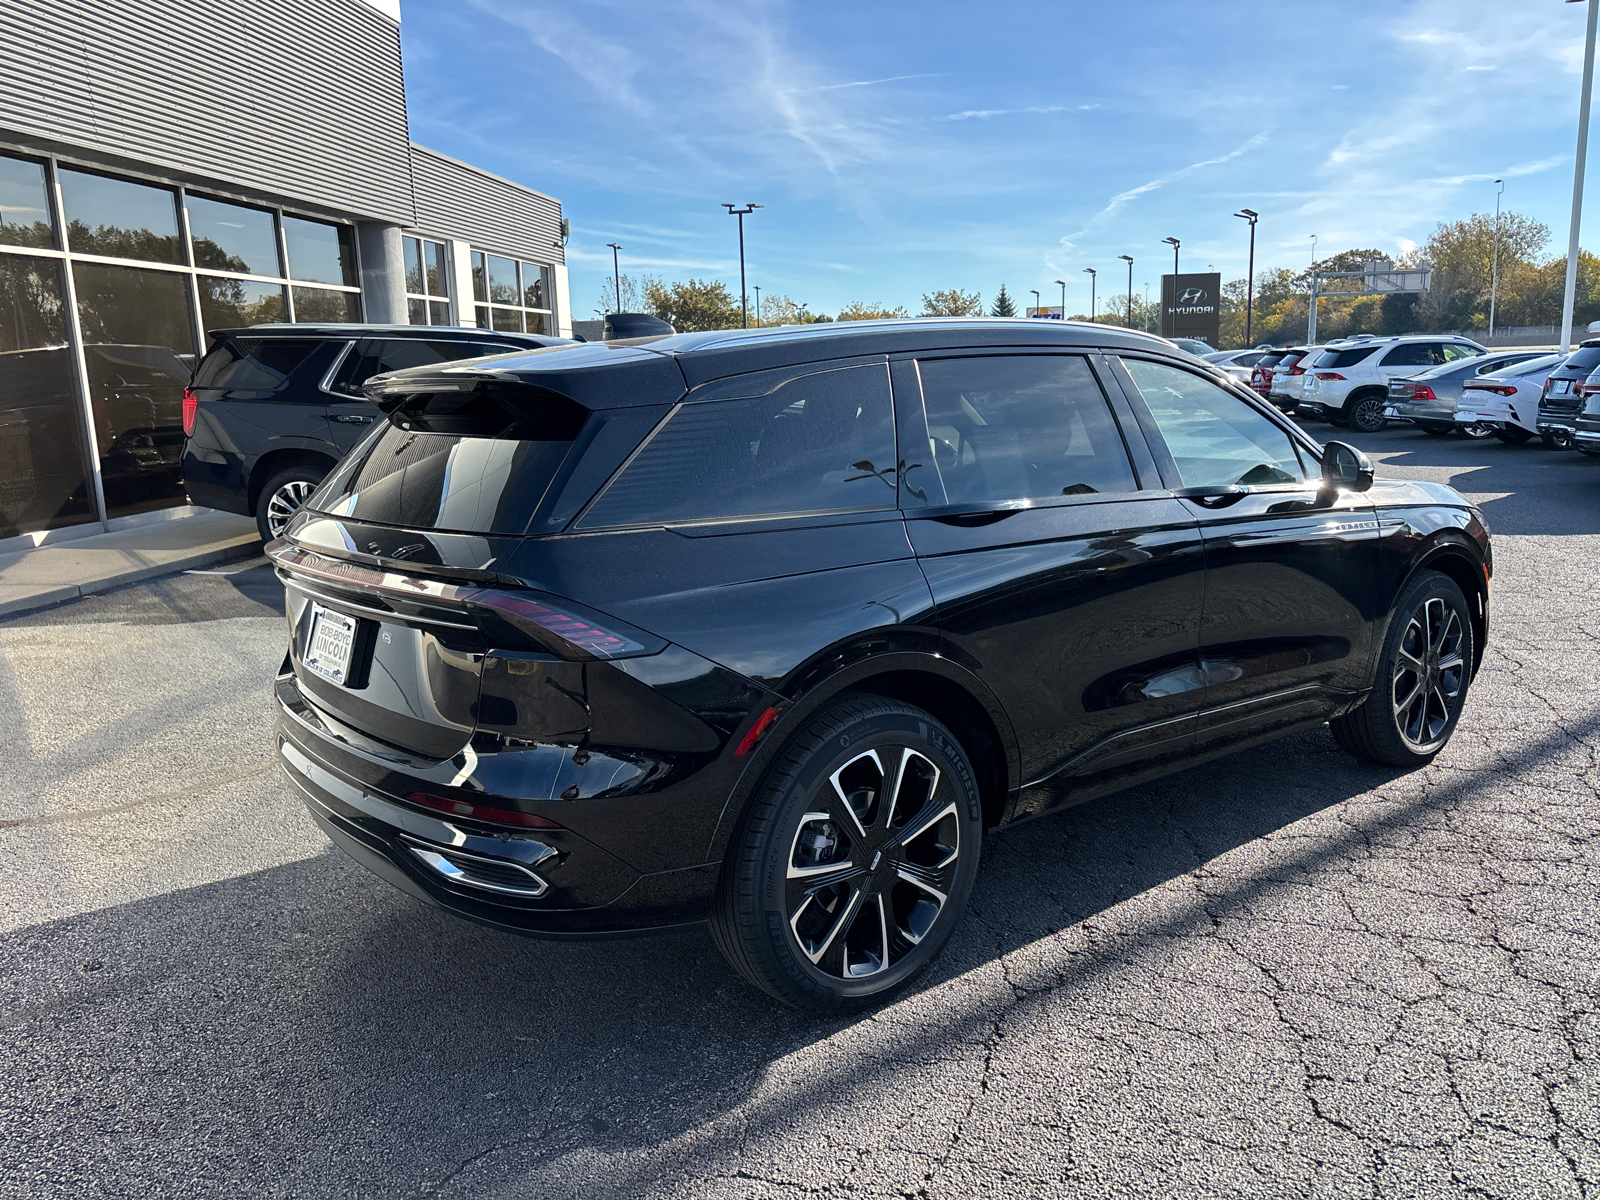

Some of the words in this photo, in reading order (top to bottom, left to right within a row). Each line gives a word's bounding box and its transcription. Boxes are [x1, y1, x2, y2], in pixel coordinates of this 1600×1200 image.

[1168, 306, 1214, 315] HYUNDAI
[316, 635, 348, 661] LINCOLN
[320, 624, 351, 646] BOB-BOYD
[944, 744, 978, 818] MICHELIN
[766, 846, 779, 899] PRIMACY
[776, 830, 784, 842] ALL
[782, 794, 799, 825] SEASON
